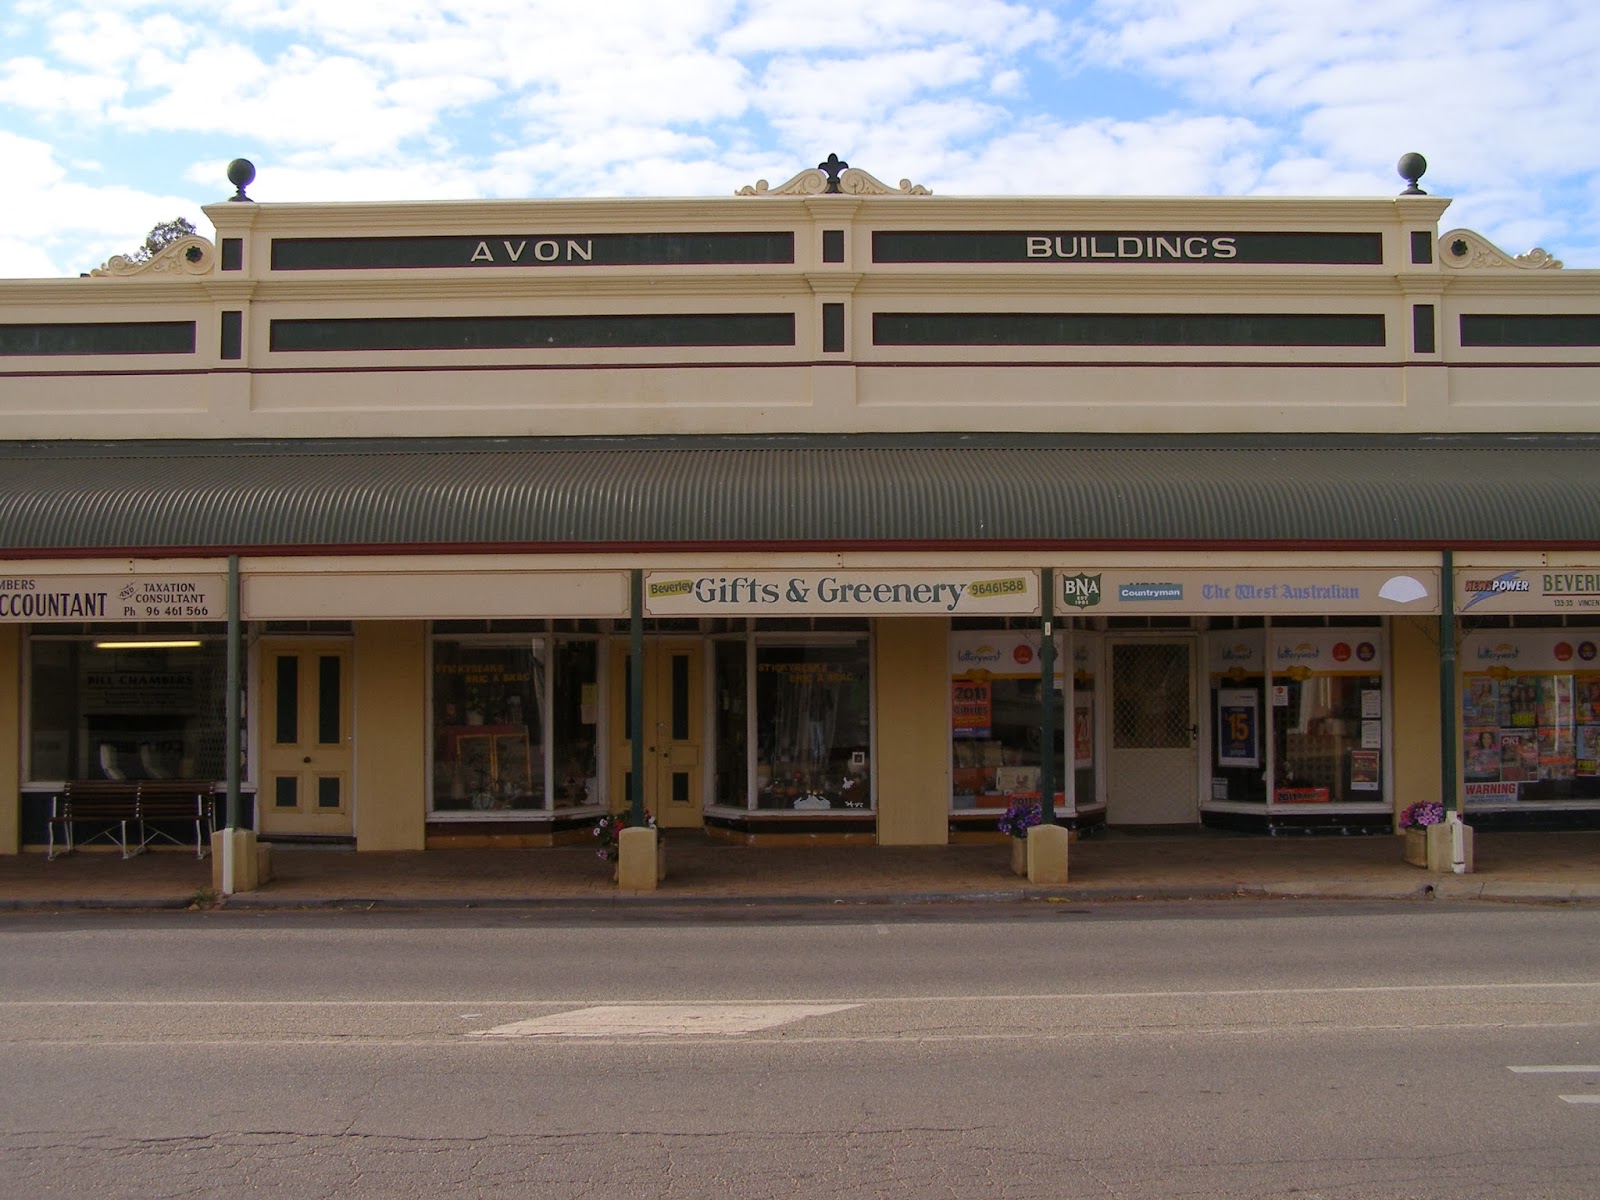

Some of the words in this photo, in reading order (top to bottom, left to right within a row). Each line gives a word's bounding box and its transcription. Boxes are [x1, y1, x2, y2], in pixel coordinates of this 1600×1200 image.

[470, 240, 593, 262] AVON
[1026, 236, 1237, 258] BUILDINGS
[144, 583, 196, 593] TAXATION
[650, 581, 694, 594] Beverley
[972, 580, 1024, 595] 96461588
[1065, 578, 1100, 596] BNA
[1202, 584, 1230, 600] The
[1235, 584, 1277, 600] West
[1281, 584, 1360, 600] Australian
[1465, 580, 1530, 592] NEWSPOWER
[135, 594, 206, 604] CONSULTANT
[695, 577, 780, 604] Gifts
[785, 577, 810, 604] &
[817, 577, 967, 611] Greenery
[1120, 589, 1181, 598] Countryman
[124, 606, 136, 616] Ph
[146, 606, 160, 616] 96
[164, 606, 183, 616] 461
[186, 606, 208, 616] 566
[957, 649, 1001, 664] lotterywest
[1477, 646, 1519, 661] lotterywest
[119, 676, 193, 685] CHAMBERS
[954, 687, 987, 699] 2011
[1502, 737, 1519, 745] OK!
[1466, 783, 1516, 795] WARNING
